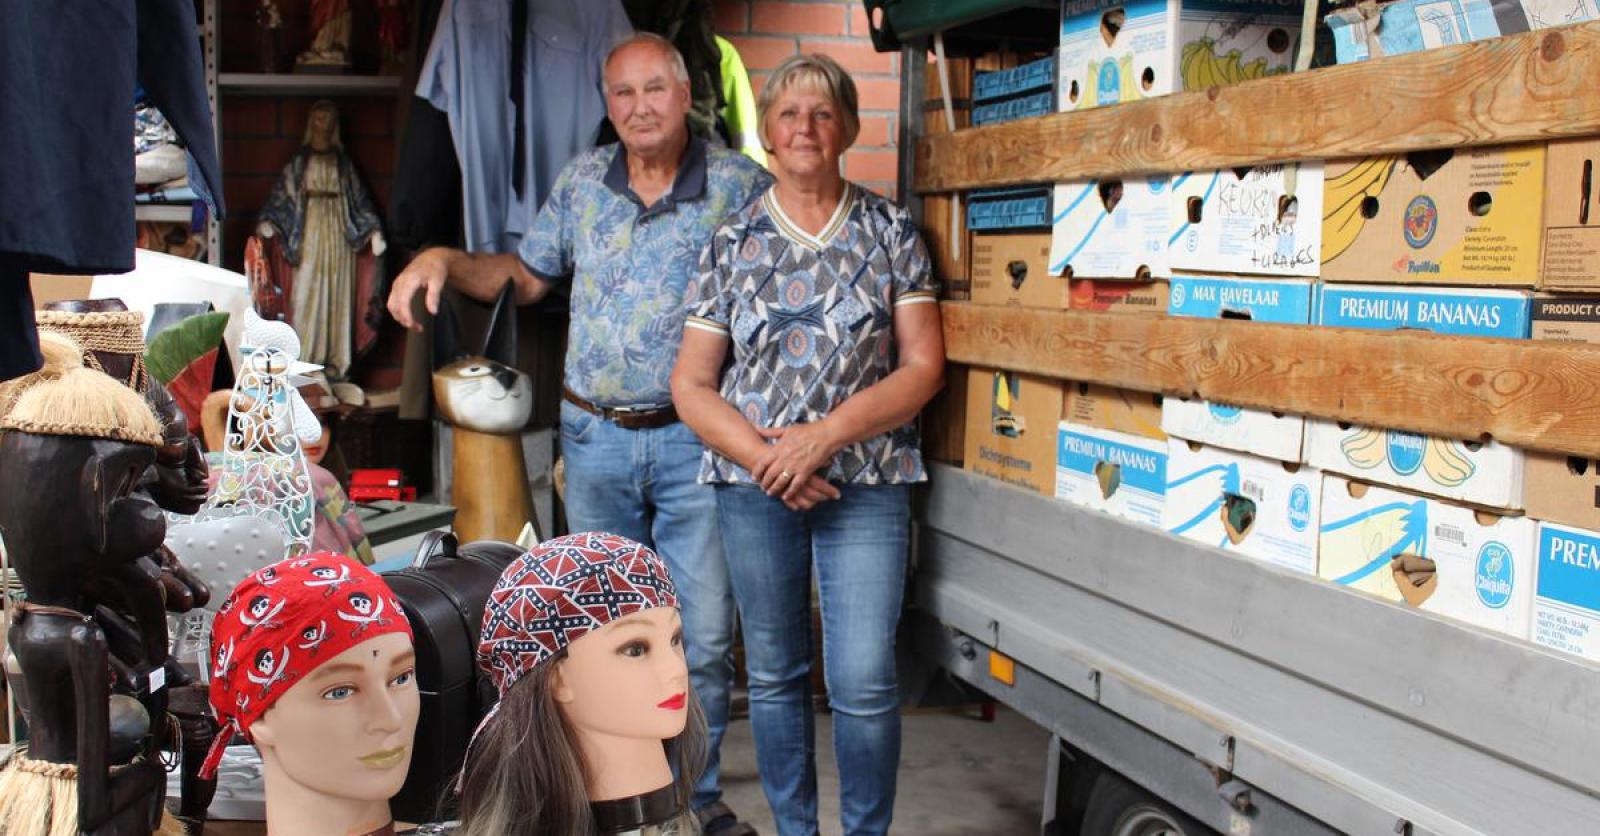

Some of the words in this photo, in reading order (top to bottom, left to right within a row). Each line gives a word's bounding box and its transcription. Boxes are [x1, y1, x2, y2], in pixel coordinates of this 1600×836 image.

[1192, 285, 1217, 301] MAX
[1221, 286, 1280, 306] HAVELAAR
[1340, 297, 1409, 321] PREMIUM
[1417, 301, 1501, 328] BANANAS
[1542, 303, 1592, 315] PRODUCT
[1064, 435, 1105, 459] PREMIUM
[1109, 446, 1157, 473] BANANAS
